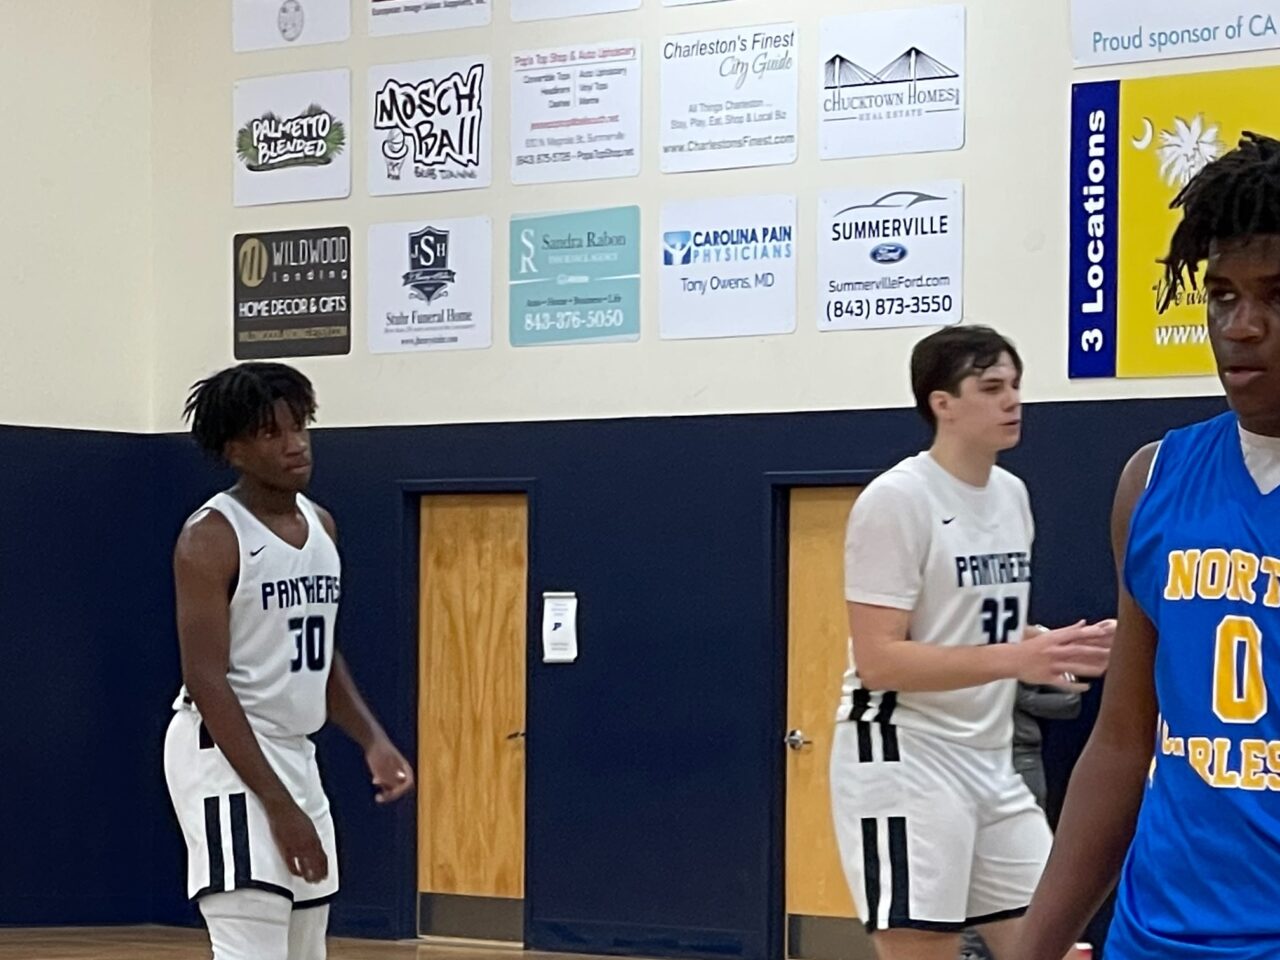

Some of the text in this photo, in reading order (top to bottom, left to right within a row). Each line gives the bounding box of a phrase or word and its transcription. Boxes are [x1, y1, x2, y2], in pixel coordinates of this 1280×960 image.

[663, 31, 795, 60] Charleston's Finest
[1093, 27, 1143, 52] Proud
[1149, 24, 1218, 53] sponsor
[1226, 15, 1245, 40] of
[1248, 14, 1276, 37] CA
[719, 49, 793, 90] City Guide
[823, 91, 904, 112] CHUCKTOWN
[908, 87, 955, 105] HOMES
[252, 112, 331, 146] PALMETTO
[257, 138, 327, 164] BLENDED
[1081, 110, 1106, 314] Locations
[541, 230, 626, 250] Sandra Rabon
[693, 226, 792, 247] CAROLINA PAIN
[832, 215, 949, 241] SUMMERVILLE
[272, 236, 348, 266] WILDWOOD
[693, 243, 792, 263] PHYSICIANS
[680, 277, 708, 295] Tony
[754, 272, 775, 288] MD
[828, 275, 951, 293] SummervilleFord.com
[239, 295, 347, 317] HOME DECOR & GIFTS
[826, 294, 953, 322] (843) 873-3550
[523, 308, 624, 331] 843-376-5050
[1081, 327, 1103, 352] 3
[288, 615, 326, 673] 30
[1212, 614, 1268, 724] 0
